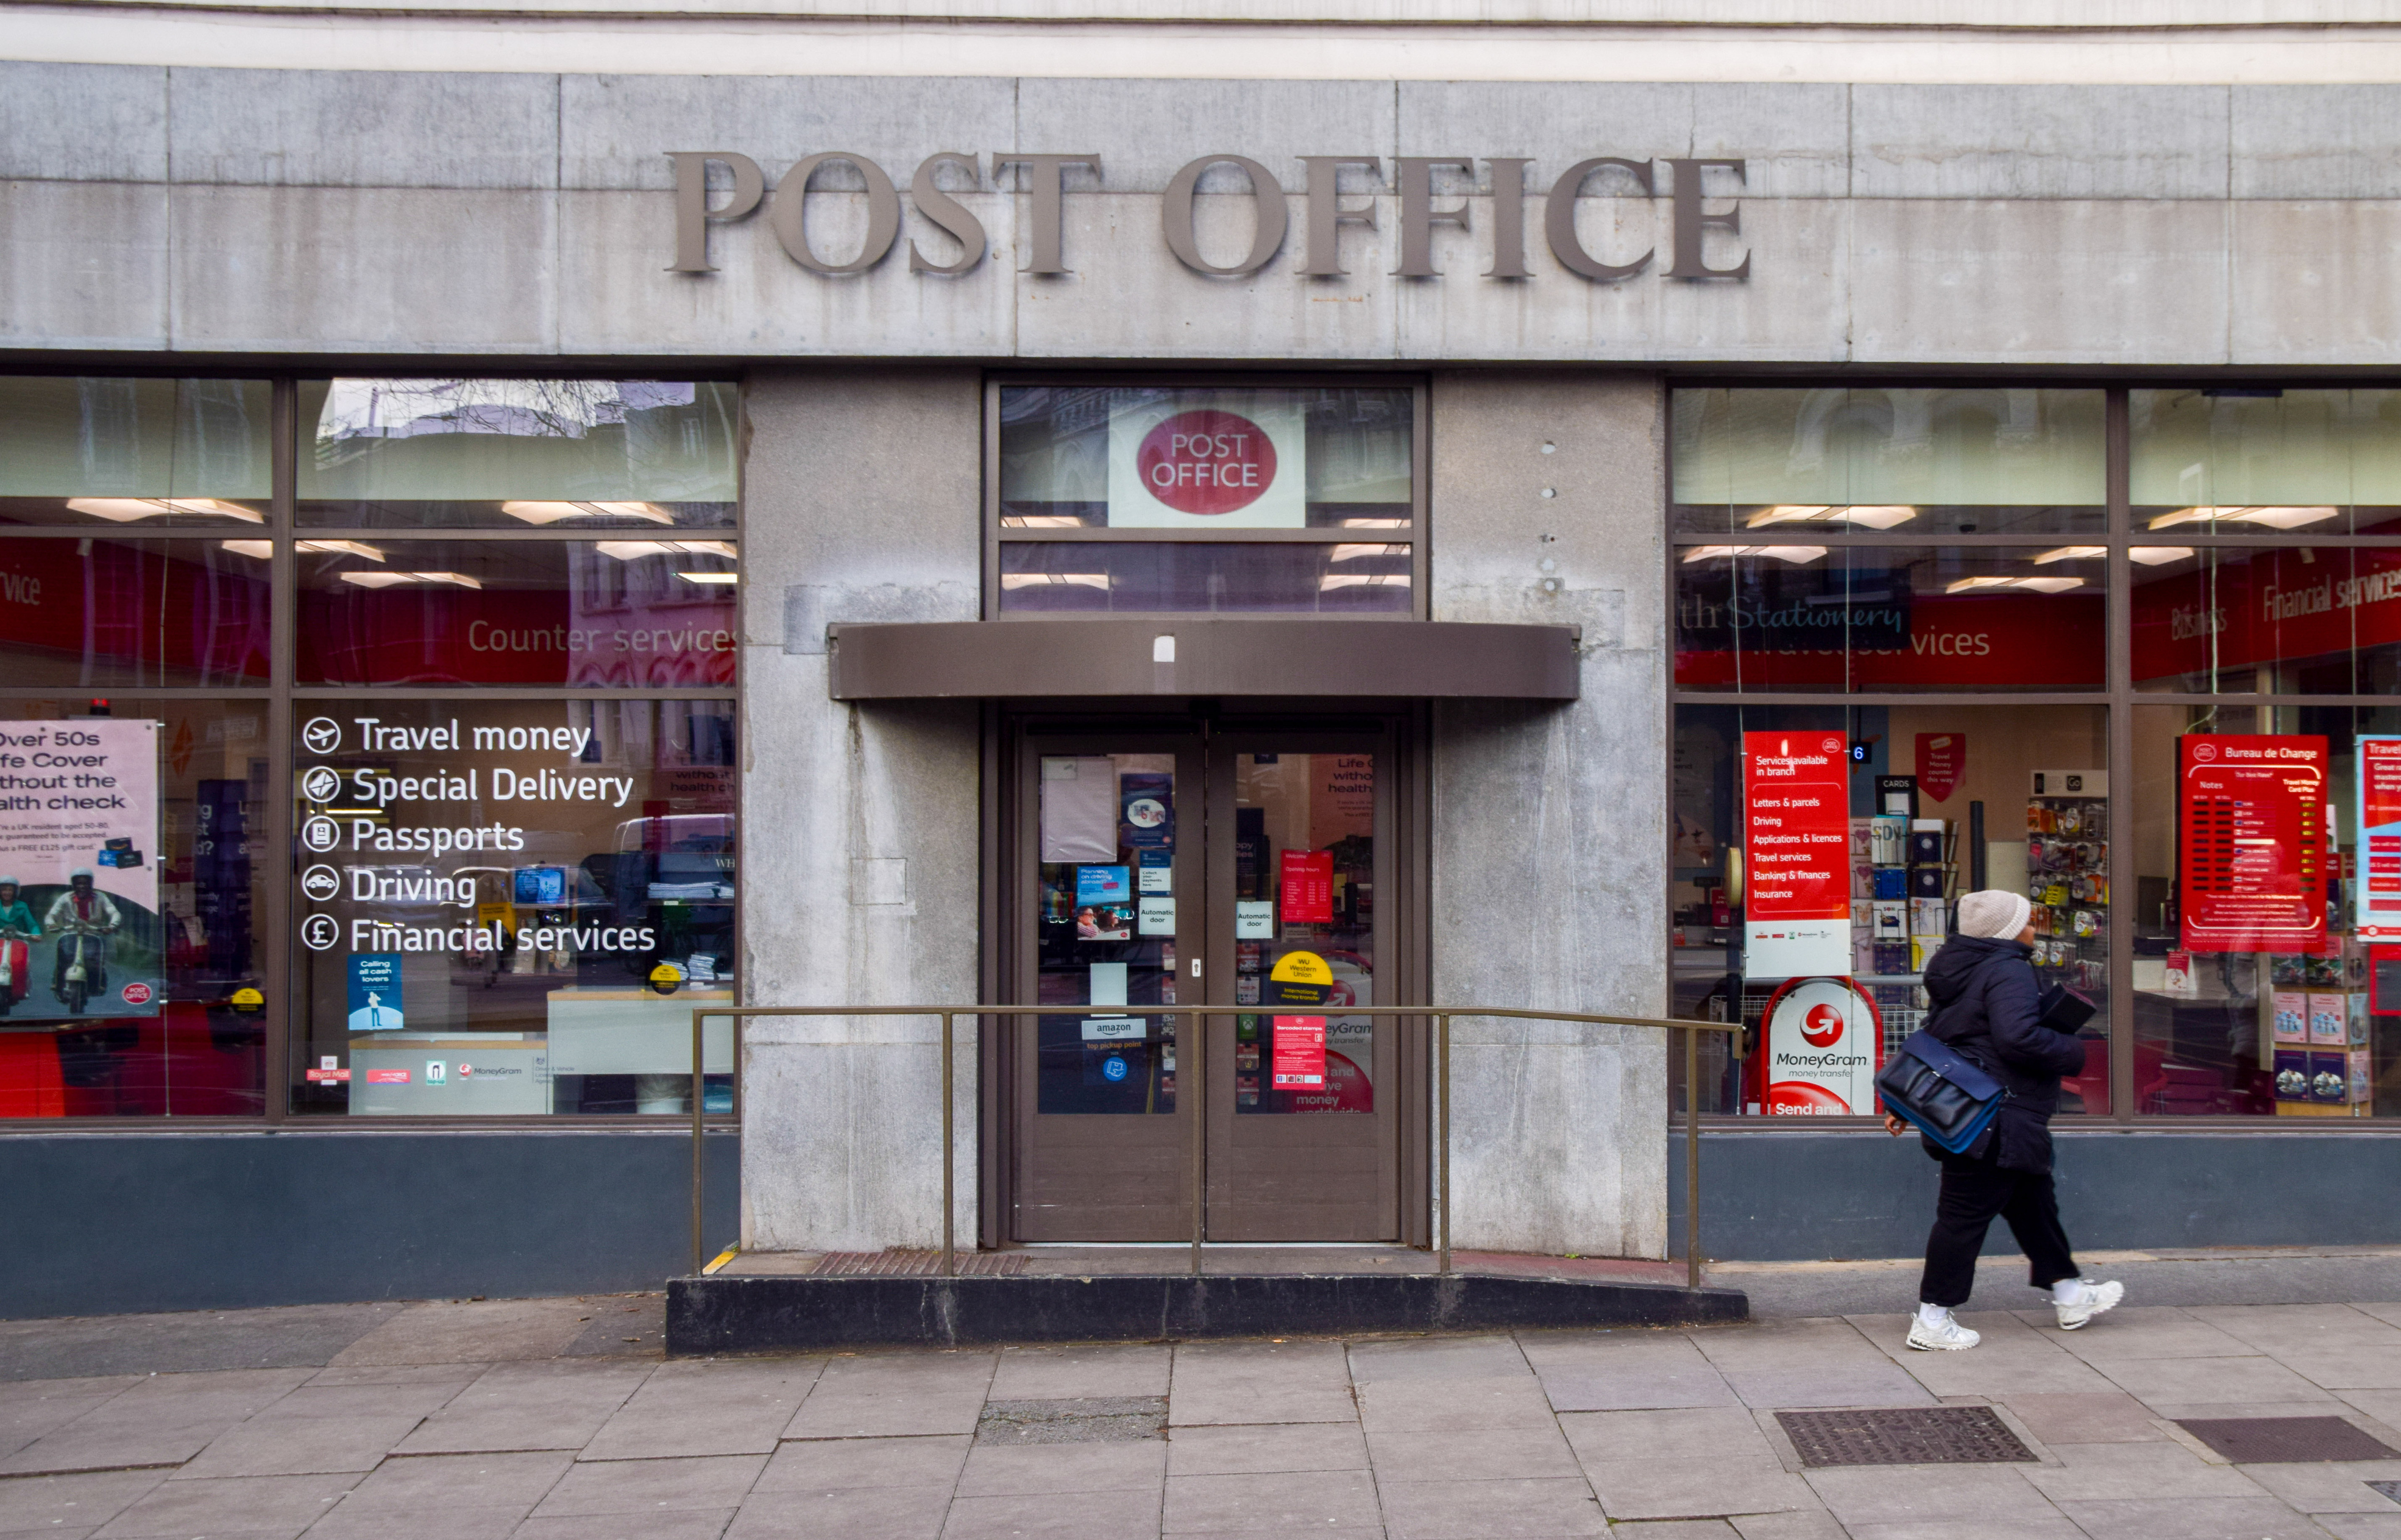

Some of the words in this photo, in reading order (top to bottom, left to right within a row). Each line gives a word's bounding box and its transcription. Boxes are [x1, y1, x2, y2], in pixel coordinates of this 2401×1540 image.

[663, 151, 1101, 274] POST
[1162, 153, 1751, 279] OFFICE
[1171, 433, 1249, 458] POST
[1152, 462, 1259, 488] OFFICE
[1726, 596, 1901, 633] Stationery
[469, 620, 596, 653] Counter
[54, 731, 100, 747] 50s
[355, 719, 459, 751] Travel
[474, 726, 591, 757] money
[1853, 747, 1864, 759] 6
[2225, 747, 2261, 758] Bureau
[2264, 748, 2277, 758] de
[2280, 748, 2318, 760] Change
[2368, 743, 2401, 754] Travel
[32, 753, 108, 768] Cover
[1338, 759, 1364, 768] Life
[1756, 756, 1790, 765] Services
[1793, 756, 1828, 765] available
[1756, 767, 1764, 776] in
[74, 773, 117, 788] the
[671, 782, 715, 792] health
[353, 768, 478, 807] Special
[493, 768, 634, 807] Delivery
[1328, 784, 1372, 792] health
[47, 795, 126, 810] check
[1753, 798, 1781, 807] Letters
[1783, 798, 1790, 807] &
[1792, 798, 1820, 808] parcels
[1753, 816, 1782, 826] Driving
[352, 818, 524, 857] Passports
[1753, 835, 1800, 845] Applications
[1803, 834, 1809, 843] &
[1812, 834, 1842, 843] licences
[1754, 853, 1777, 862] Travel
[1780, 853, 1811, 861] services
[1754, 871, 1786, 881] Banking
[1789, 870, 1796, 879] &
[1798, 870, 1831, 879] finances
[353, 870, 476, 908] Driving
[1754, 890, 1793, 899] Insurance
[352, 919, 503, 951] Financial
[516, 919, 655, 951] services
[1097, 1024, 1131, 1032] amazon
[1776, 1053, 1867, 1069] MoneyGram
[1330, 1066, 1355, 1077] and
[1296, 1096, 1340, 1107] money
[1776, 1102, 1812, 1115] Send
[1815, 1102, 1842, 1115] and
